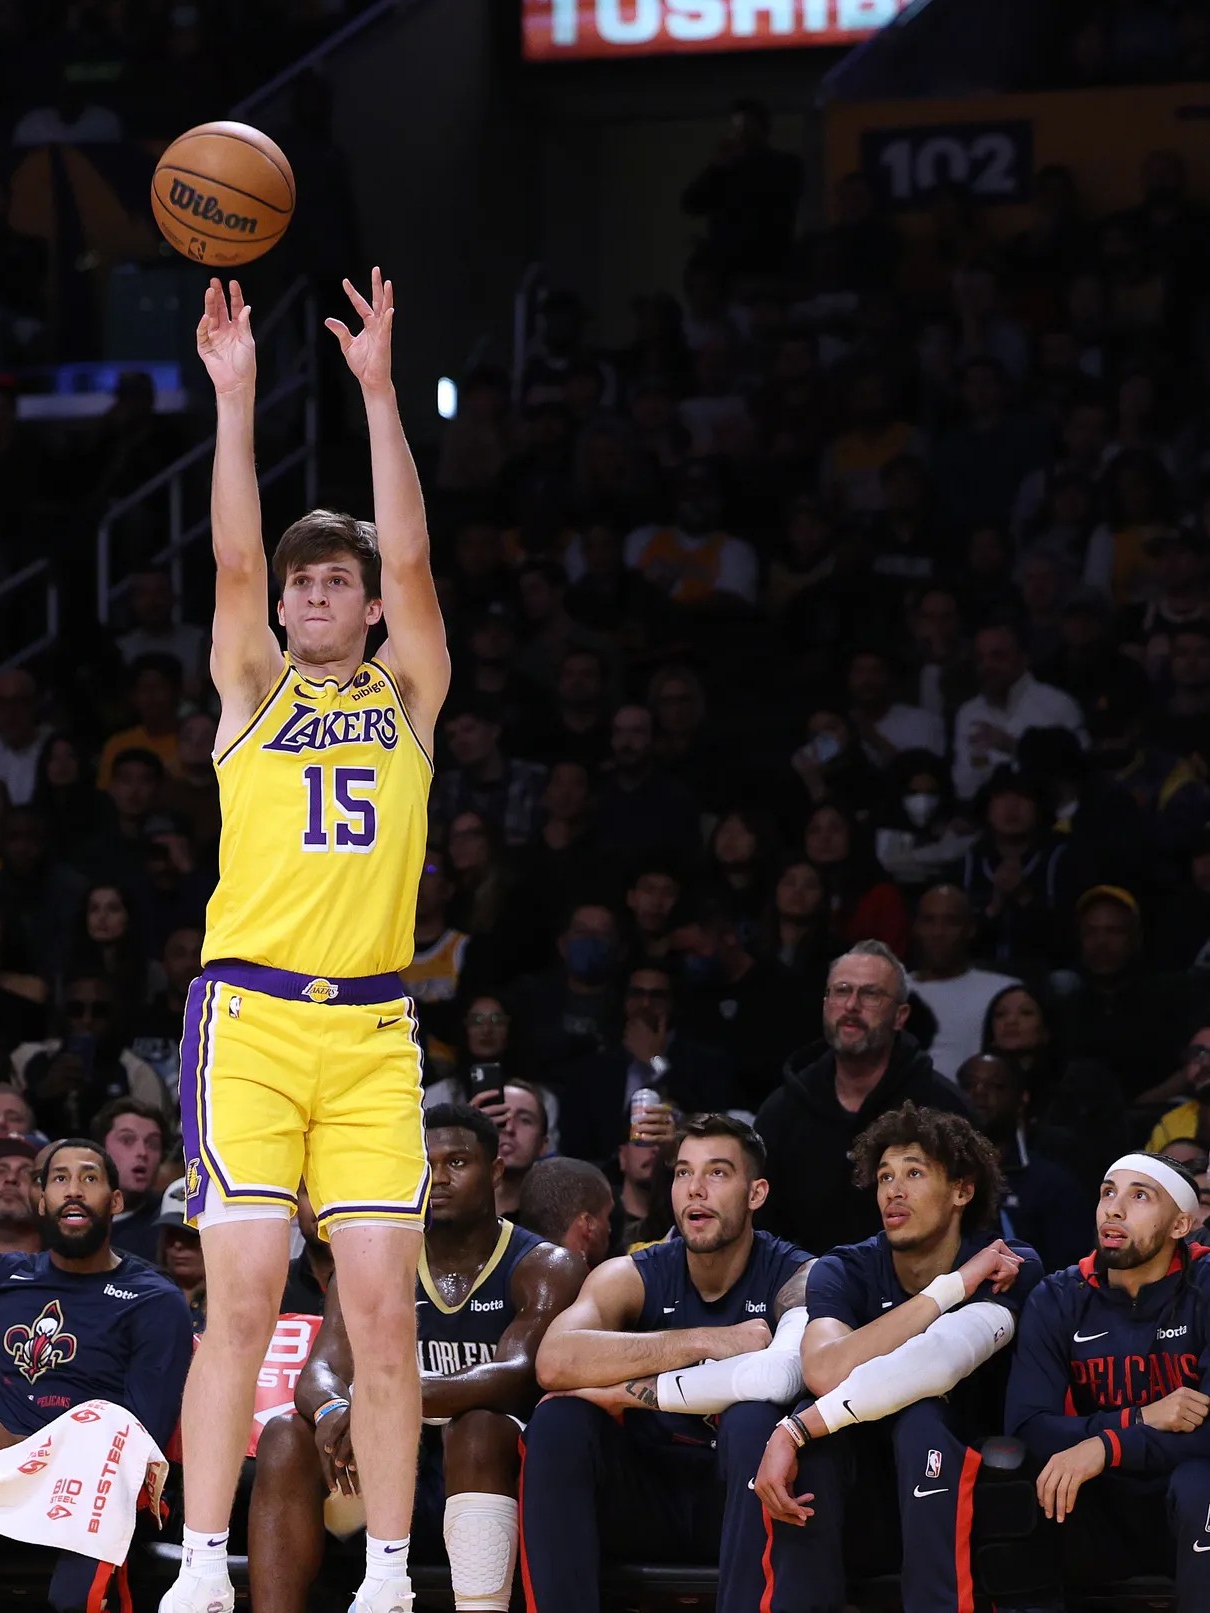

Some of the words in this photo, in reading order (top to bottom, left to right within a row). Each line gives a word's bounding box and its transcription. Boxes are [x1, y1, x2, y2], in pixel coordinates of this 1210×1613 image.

[540, 0, 900, 46] TOSHIB
[879, 132, 1016, 199] 102
[169, 178, 258, 234] Wilson
[351, 680, 385, 701] bibigo
[262, 702, 399, 753] LAKERS
[302, 764, 377, 853] 15
[470, 1300, 504, 1312] ibotta
[1156, 1325, 1187, 1340] ibotta
[428, 1340, 498, 1375] ORLEA
[1070, 1352, 1200, 1406] PELCANS
[37, 1395, 70, 1409] PELICANS
[53, 1478, 83, 1495] BIO
[88, 1424, 130, 1533] BIOSTEEL
[50, 1495, 76, 1504] STEEL
